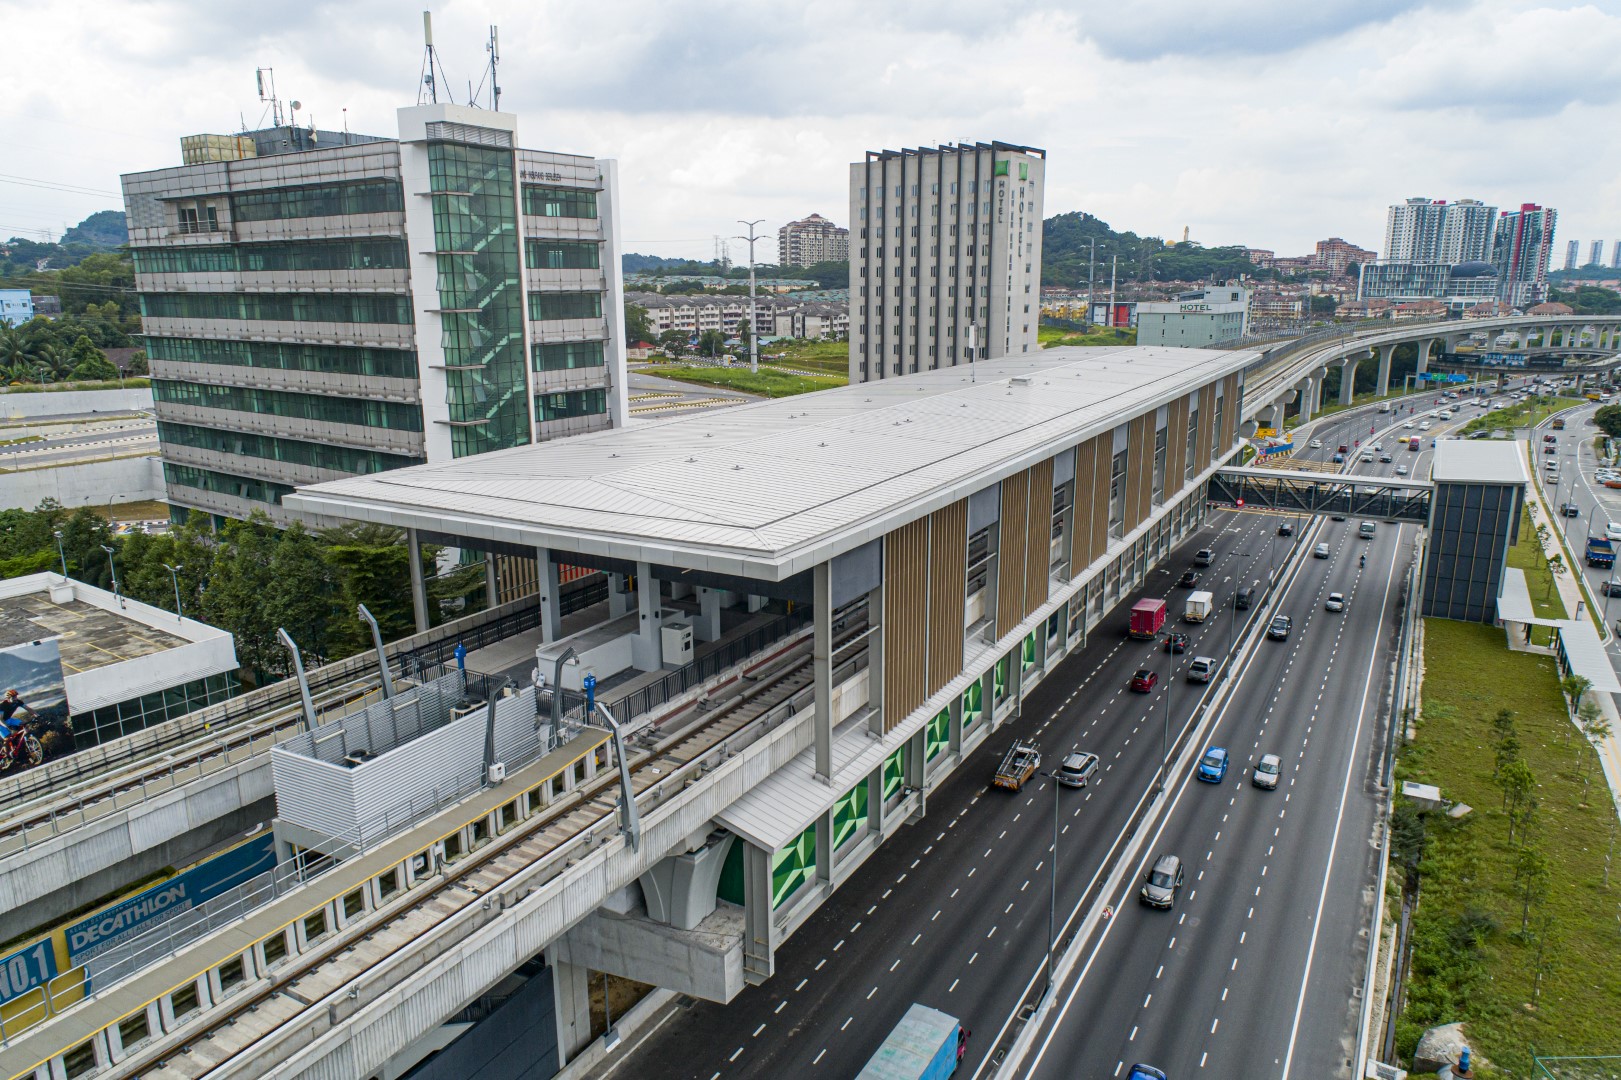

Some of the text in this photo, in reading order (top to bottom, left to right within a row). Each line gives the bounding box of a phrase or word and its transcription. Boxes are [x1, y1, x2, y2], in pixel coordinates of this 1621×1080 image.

[71, 882, 186, 951] DECATHLON
[74, 945, 99, 962] SPORT
[101, 936, 117, 948] FOR
[117, 930, 130, 941] ALL
[136, 921, 149, 932] ALL
[150, 914, 164, 924] FOR
[165, 902, 186, 918] SPORT
